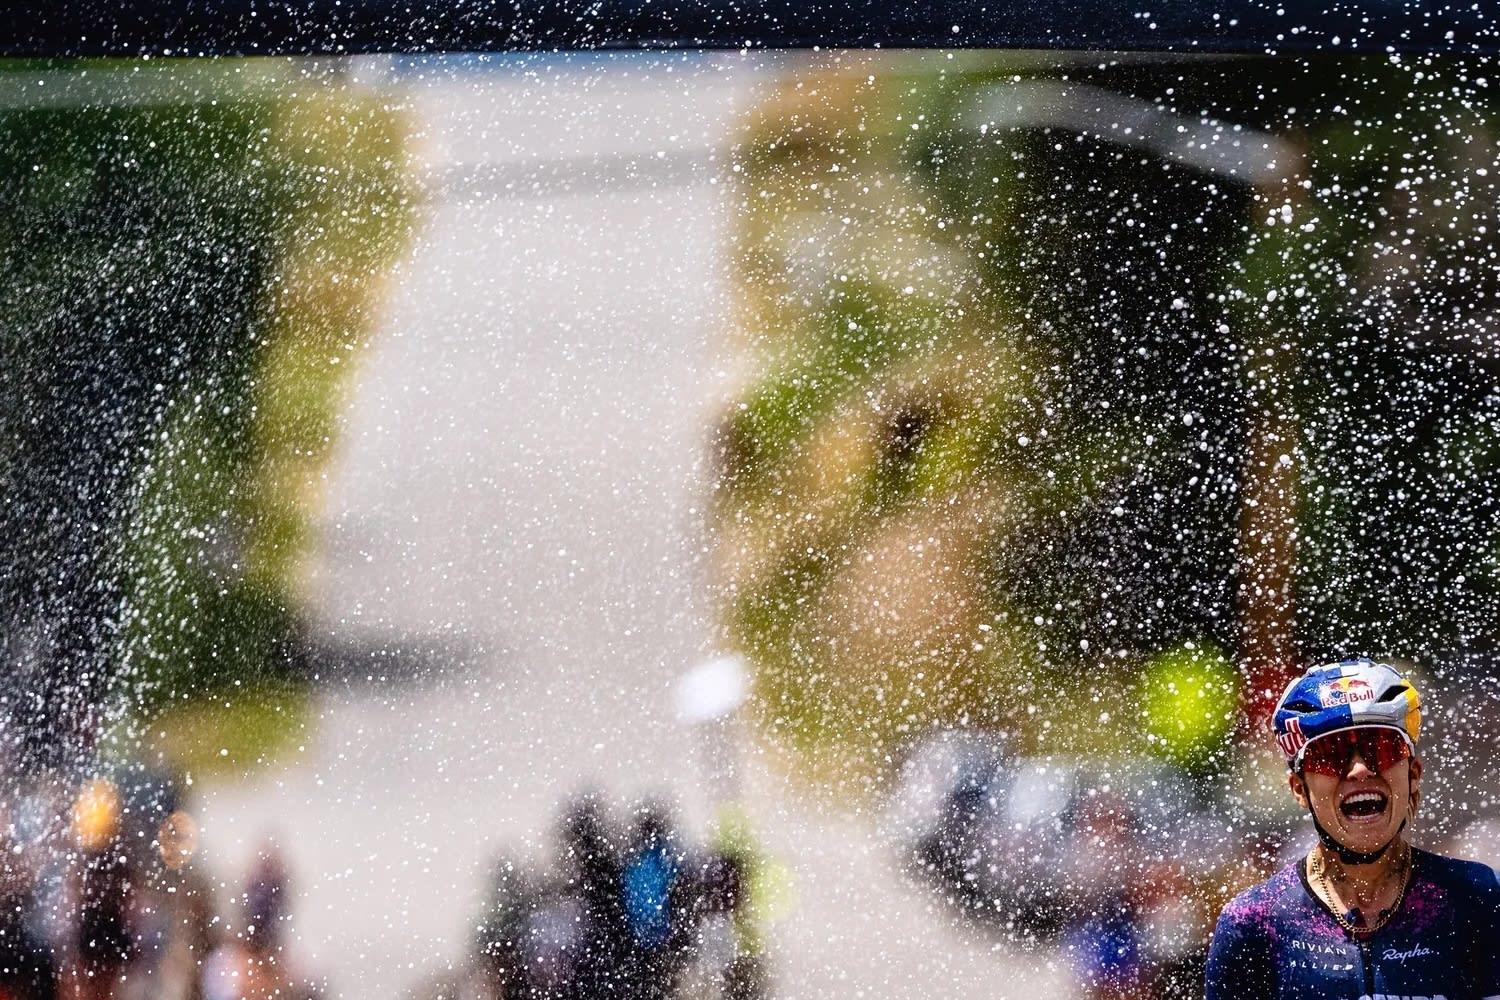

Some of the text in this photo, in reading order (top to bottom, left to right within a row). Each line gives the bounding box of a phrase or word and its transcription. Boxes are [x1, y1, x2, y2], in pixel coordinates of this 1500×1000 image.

[1349, 689, 1374, 703] Bull
[1292, 940, 1347, 955] RIVIAN
[1290, 960, 1353, 970] ALLIED
